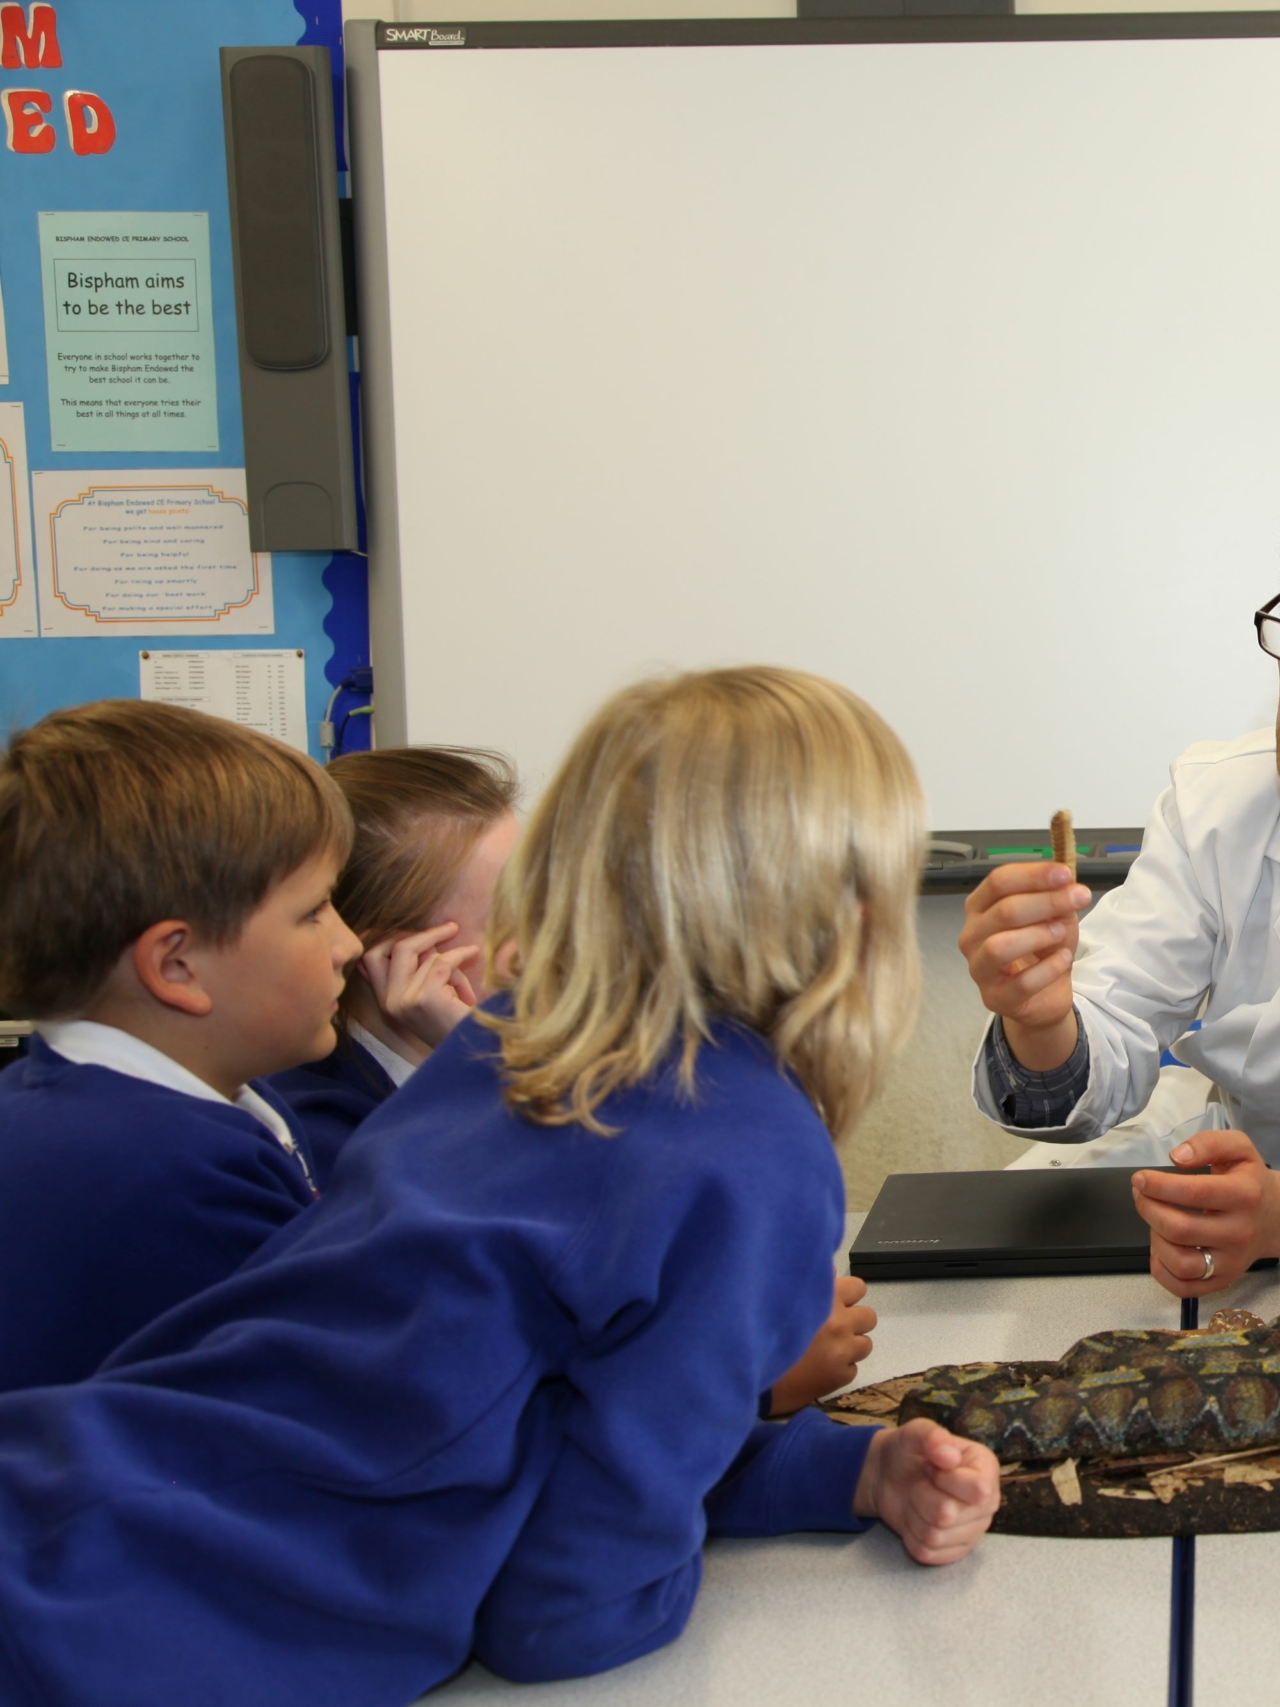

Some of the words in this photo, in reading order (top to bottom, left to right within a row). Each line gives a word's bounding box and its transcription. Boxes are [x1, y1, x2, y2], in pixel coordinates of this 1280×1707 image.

[386, 28, 431, 41] SMART
[430, 29, 462, 40] Board
[1, 90, 116, 155] ED
[67, 272, 140, 294] Bispham
[145, 272, 185, 289] aims
[62, 300, 82, 316] to
[88, 299, 110, 316] be
[115, 298, 146, 316] the
[152, 299, 192, 316] best
[57, 352, 92, 364] Everyone
[94, 352, 102, 361] in
[104, 352, 128, 361] school
[130, 352, 152, 361] works
[155, 352, 190, 362] together
[192, 353, 200, 361] to
[64, 365, 76, 374] try
[78, 364, 87, 372] to
[89, 364, 109, 372] make
[112, 364, 142, 374] Bispham
[144, 364, 178, 372] Endowed
[180, 364, 194, 372] the
[89, 376, 106, 384] best
[108, 376, 132, 384] school
[135, 376, 141, 384] it
[60, 398, 77, 406] This
[106, 398, 122, 406] that
[124, 400, 158, 408] everyone
[161, 398, 180, 406] tries
[182, 398, 201, 406] their
[76, 410, 93, 418] best
[104, 410, 114, 418] all
[116, 410, 140, 420] things
[152, 410, 161, 418] all
[98, 500, 124, 508] Bispham
